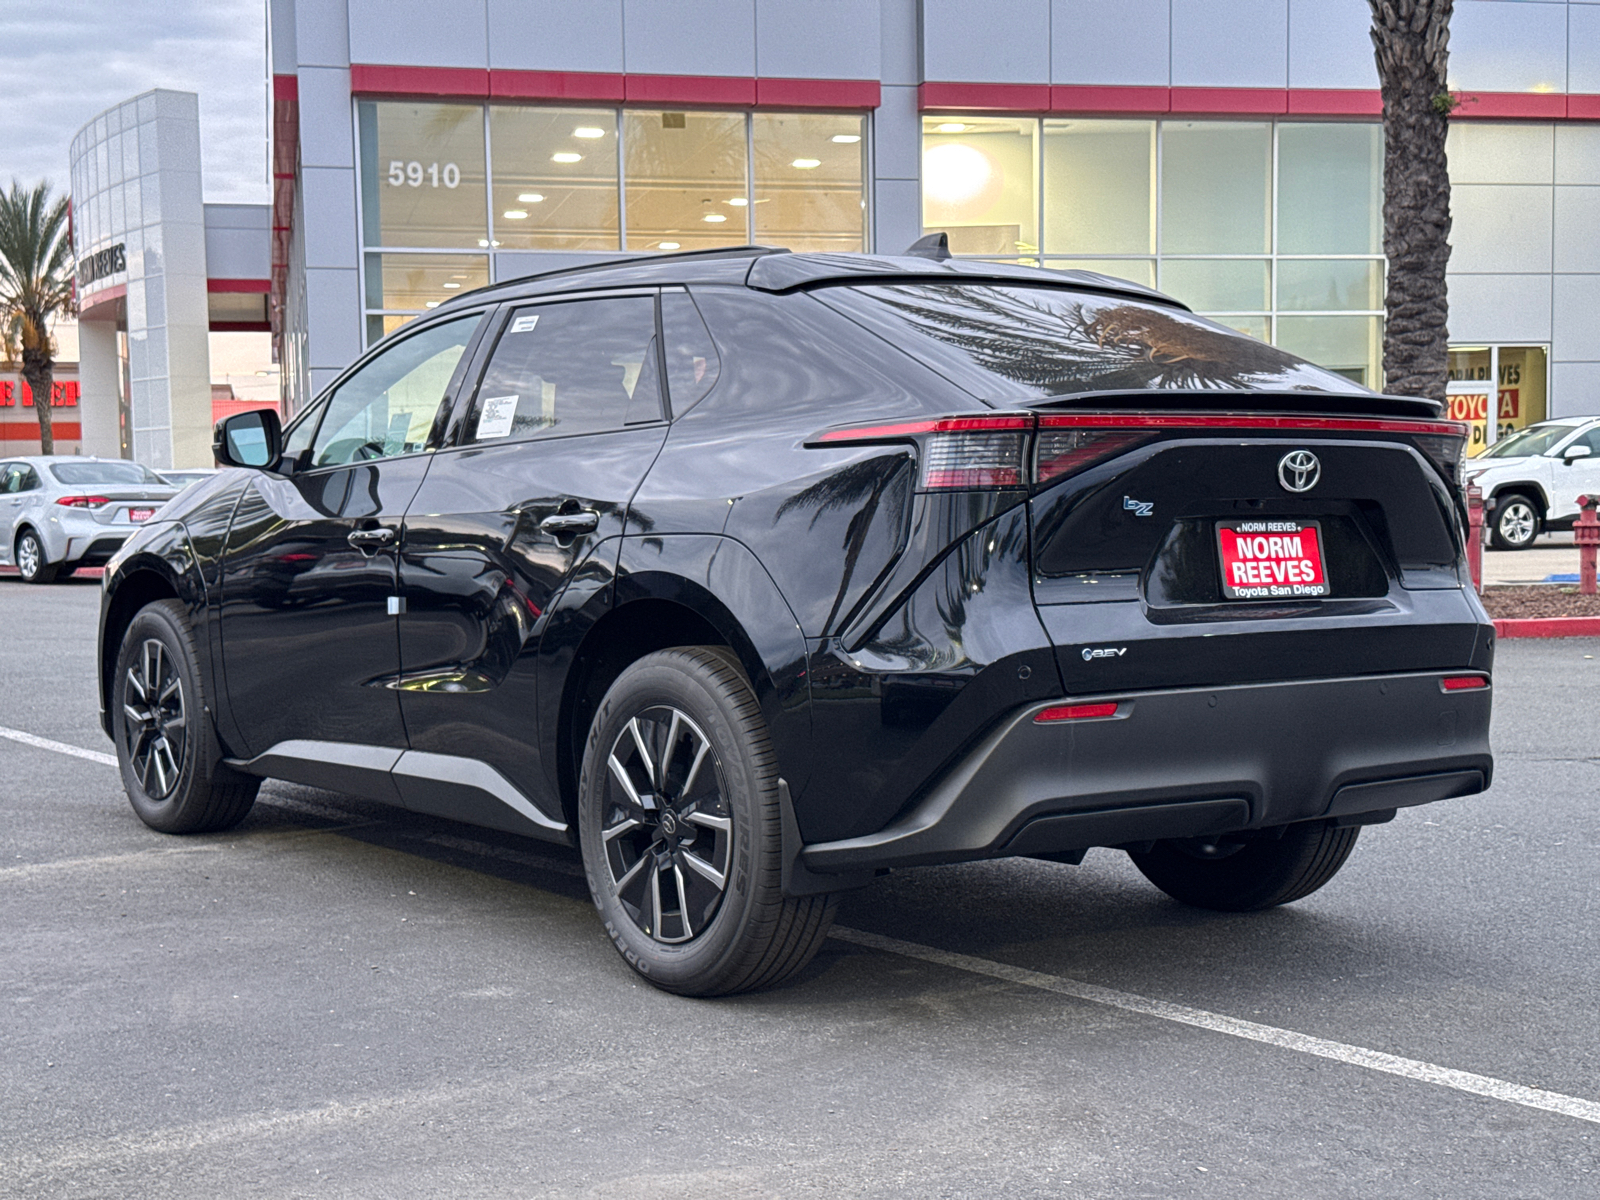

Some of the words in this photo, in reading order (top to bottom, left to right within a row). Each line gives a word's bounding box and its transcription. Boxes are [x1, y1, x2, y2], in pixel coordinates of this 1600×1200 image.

[388, 160, 461, 189] 5910
[1446, 392, 1514, 420] TOYOA
[1241, 522, 1266, 532] NORM
[1268, 522, 1297, 532] REEVES
[1236, 536, 1303, 559] NORM
[1231, 559, 1315, 584] REEVES
[1232, 586, 1269, 598] Toyota
[1270, 585, 1292, 596] San
[1293, 584, 1324, 596] Diego
[605, 921, 650, 974] OPEN
